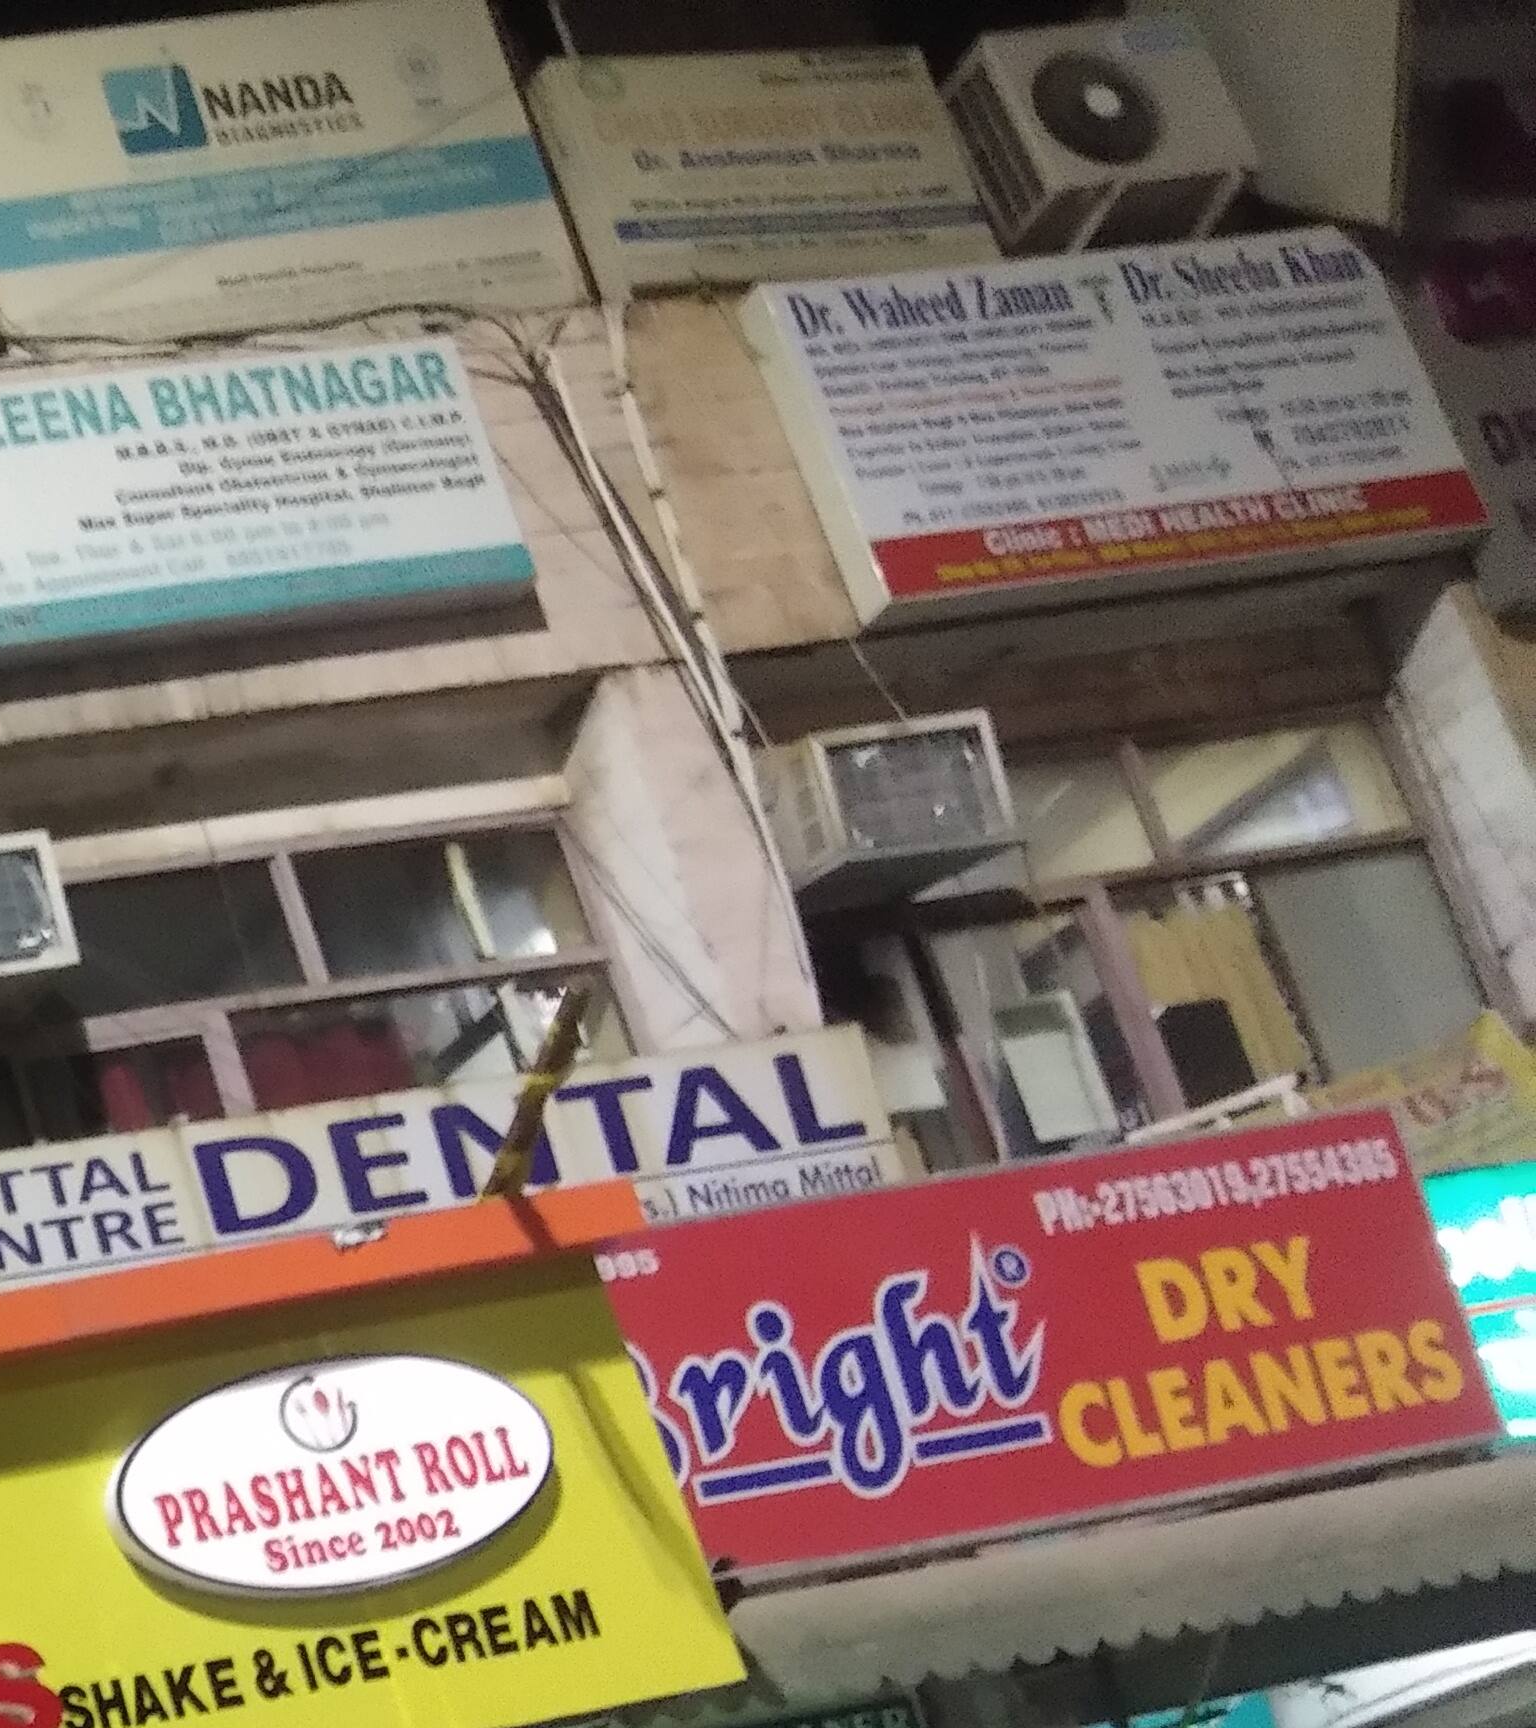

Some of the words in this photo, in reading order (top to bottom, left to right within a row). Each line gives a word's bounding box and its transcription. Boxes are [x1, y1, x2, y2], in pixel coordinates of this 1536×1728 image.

[201, 70, 356, 121] NANDA
[787, 293, 846, 338] Dr.
[842, 280, 968, 331] Waheed
[967, 274, 1074, 321] Zaman
[148, 350, 457, 428] BHATNAGAR
[192, 1051, 867, 1240] DENTAL
[686, 1176, 790, 1212] Nitima
[798, 1155, 883, 1195] Mittal
[1135, 1236, 1314, 1344] DRY
[1059, 1318, 1466, 1470] CLEANERS
[155, 1447, 407, 1548] PRASHANT
[414, 1427, 530, 1499] ROLL
[263, 1530, 367, 1573] Since
[374, 1509, 461, 1552] 2002
[253, 1648, 292, 1700] &
[297, 1589, 602, 1692] ICE-CREAM
